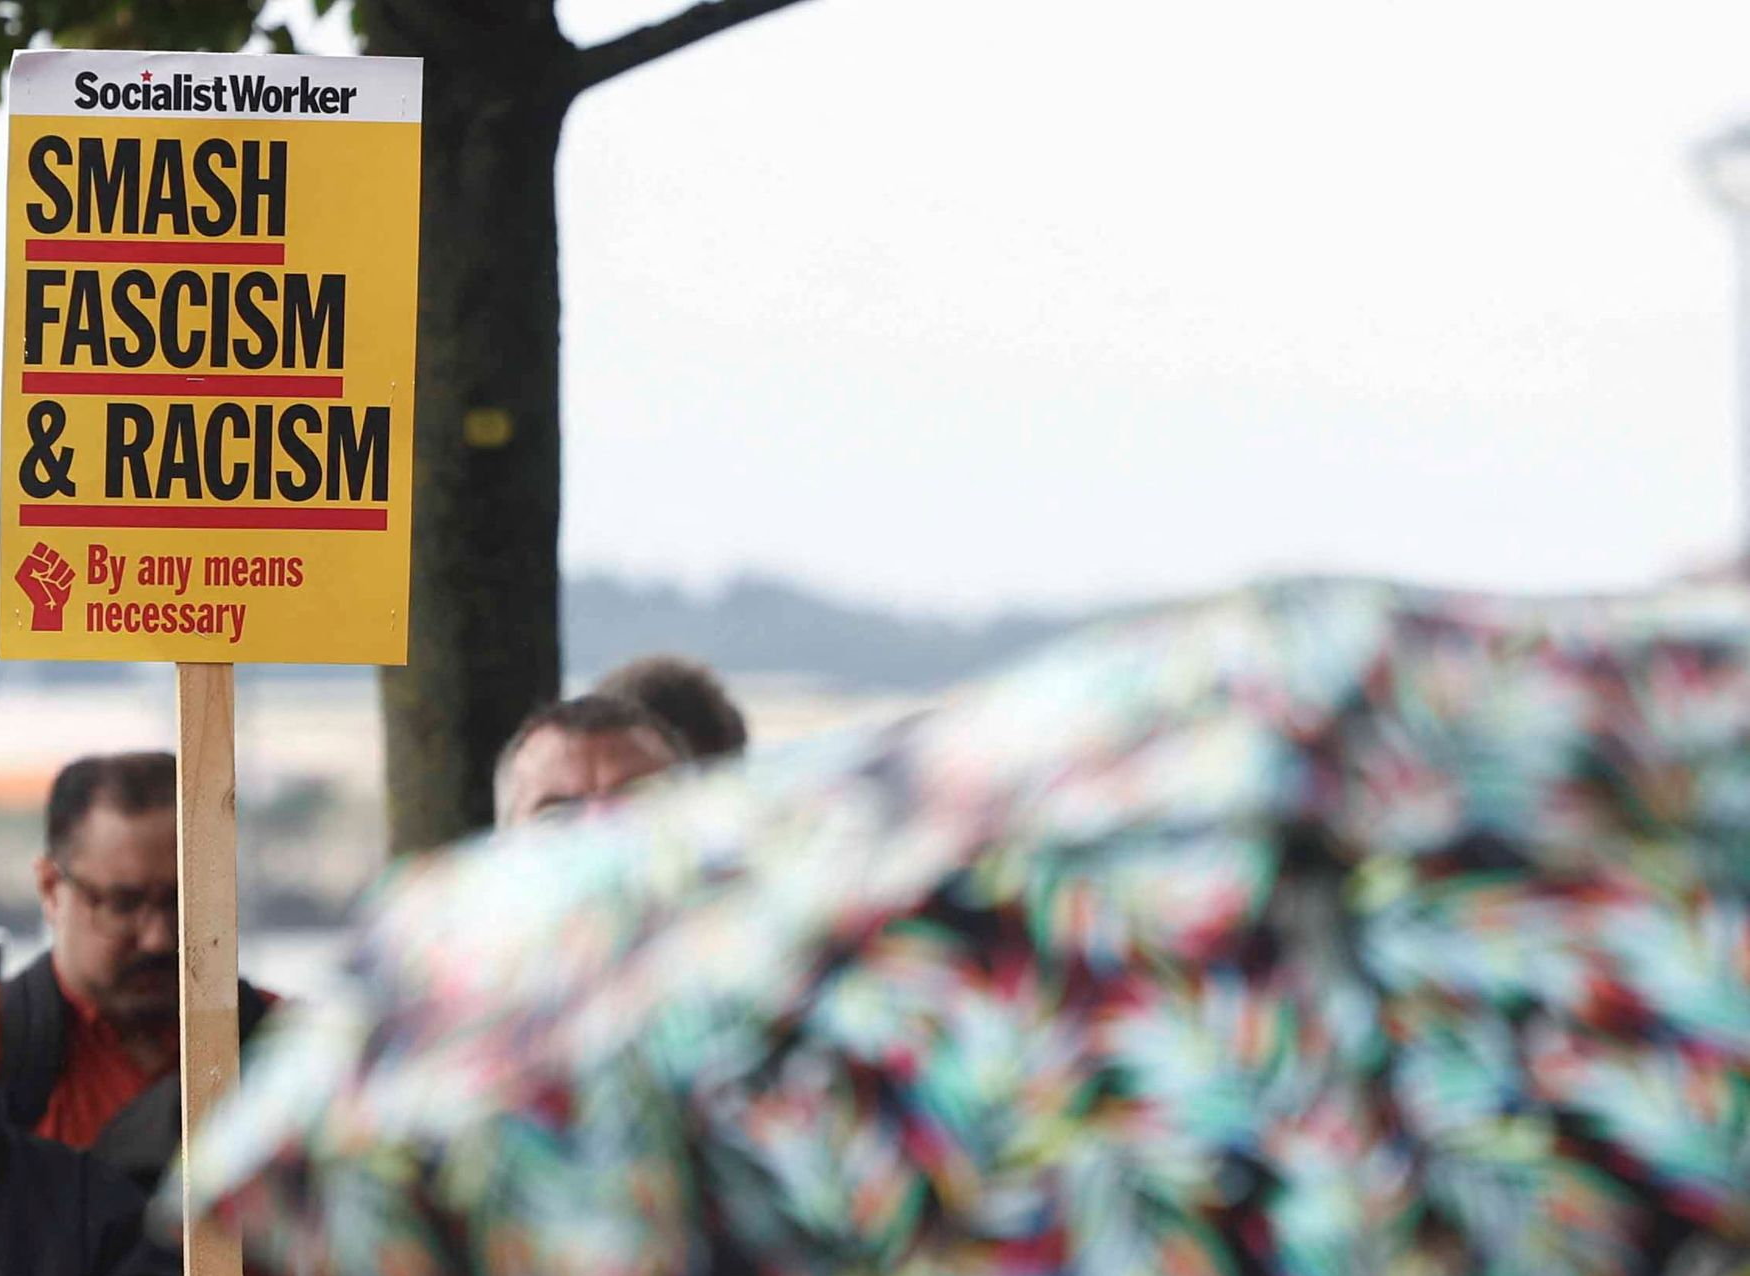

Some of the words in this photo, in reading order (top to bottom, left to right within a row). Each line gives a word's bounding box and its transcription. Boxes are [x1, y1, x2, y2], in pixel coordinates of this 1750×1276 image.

[75, 71, 227, 112] Socialist
[229, 74, 356, 114] Worker
[26, 135, 287, 236] SMASH
[24, 269, 346, 369] FASCISM
[19, 400, 76, 498] &
[106, 402, 391, 501] RACISM
[87, 544, 126, 593] By
[138, 555, 192, 595] any
[204, 556, 303, 587] means
[86, 602, 246, 643] necessary
